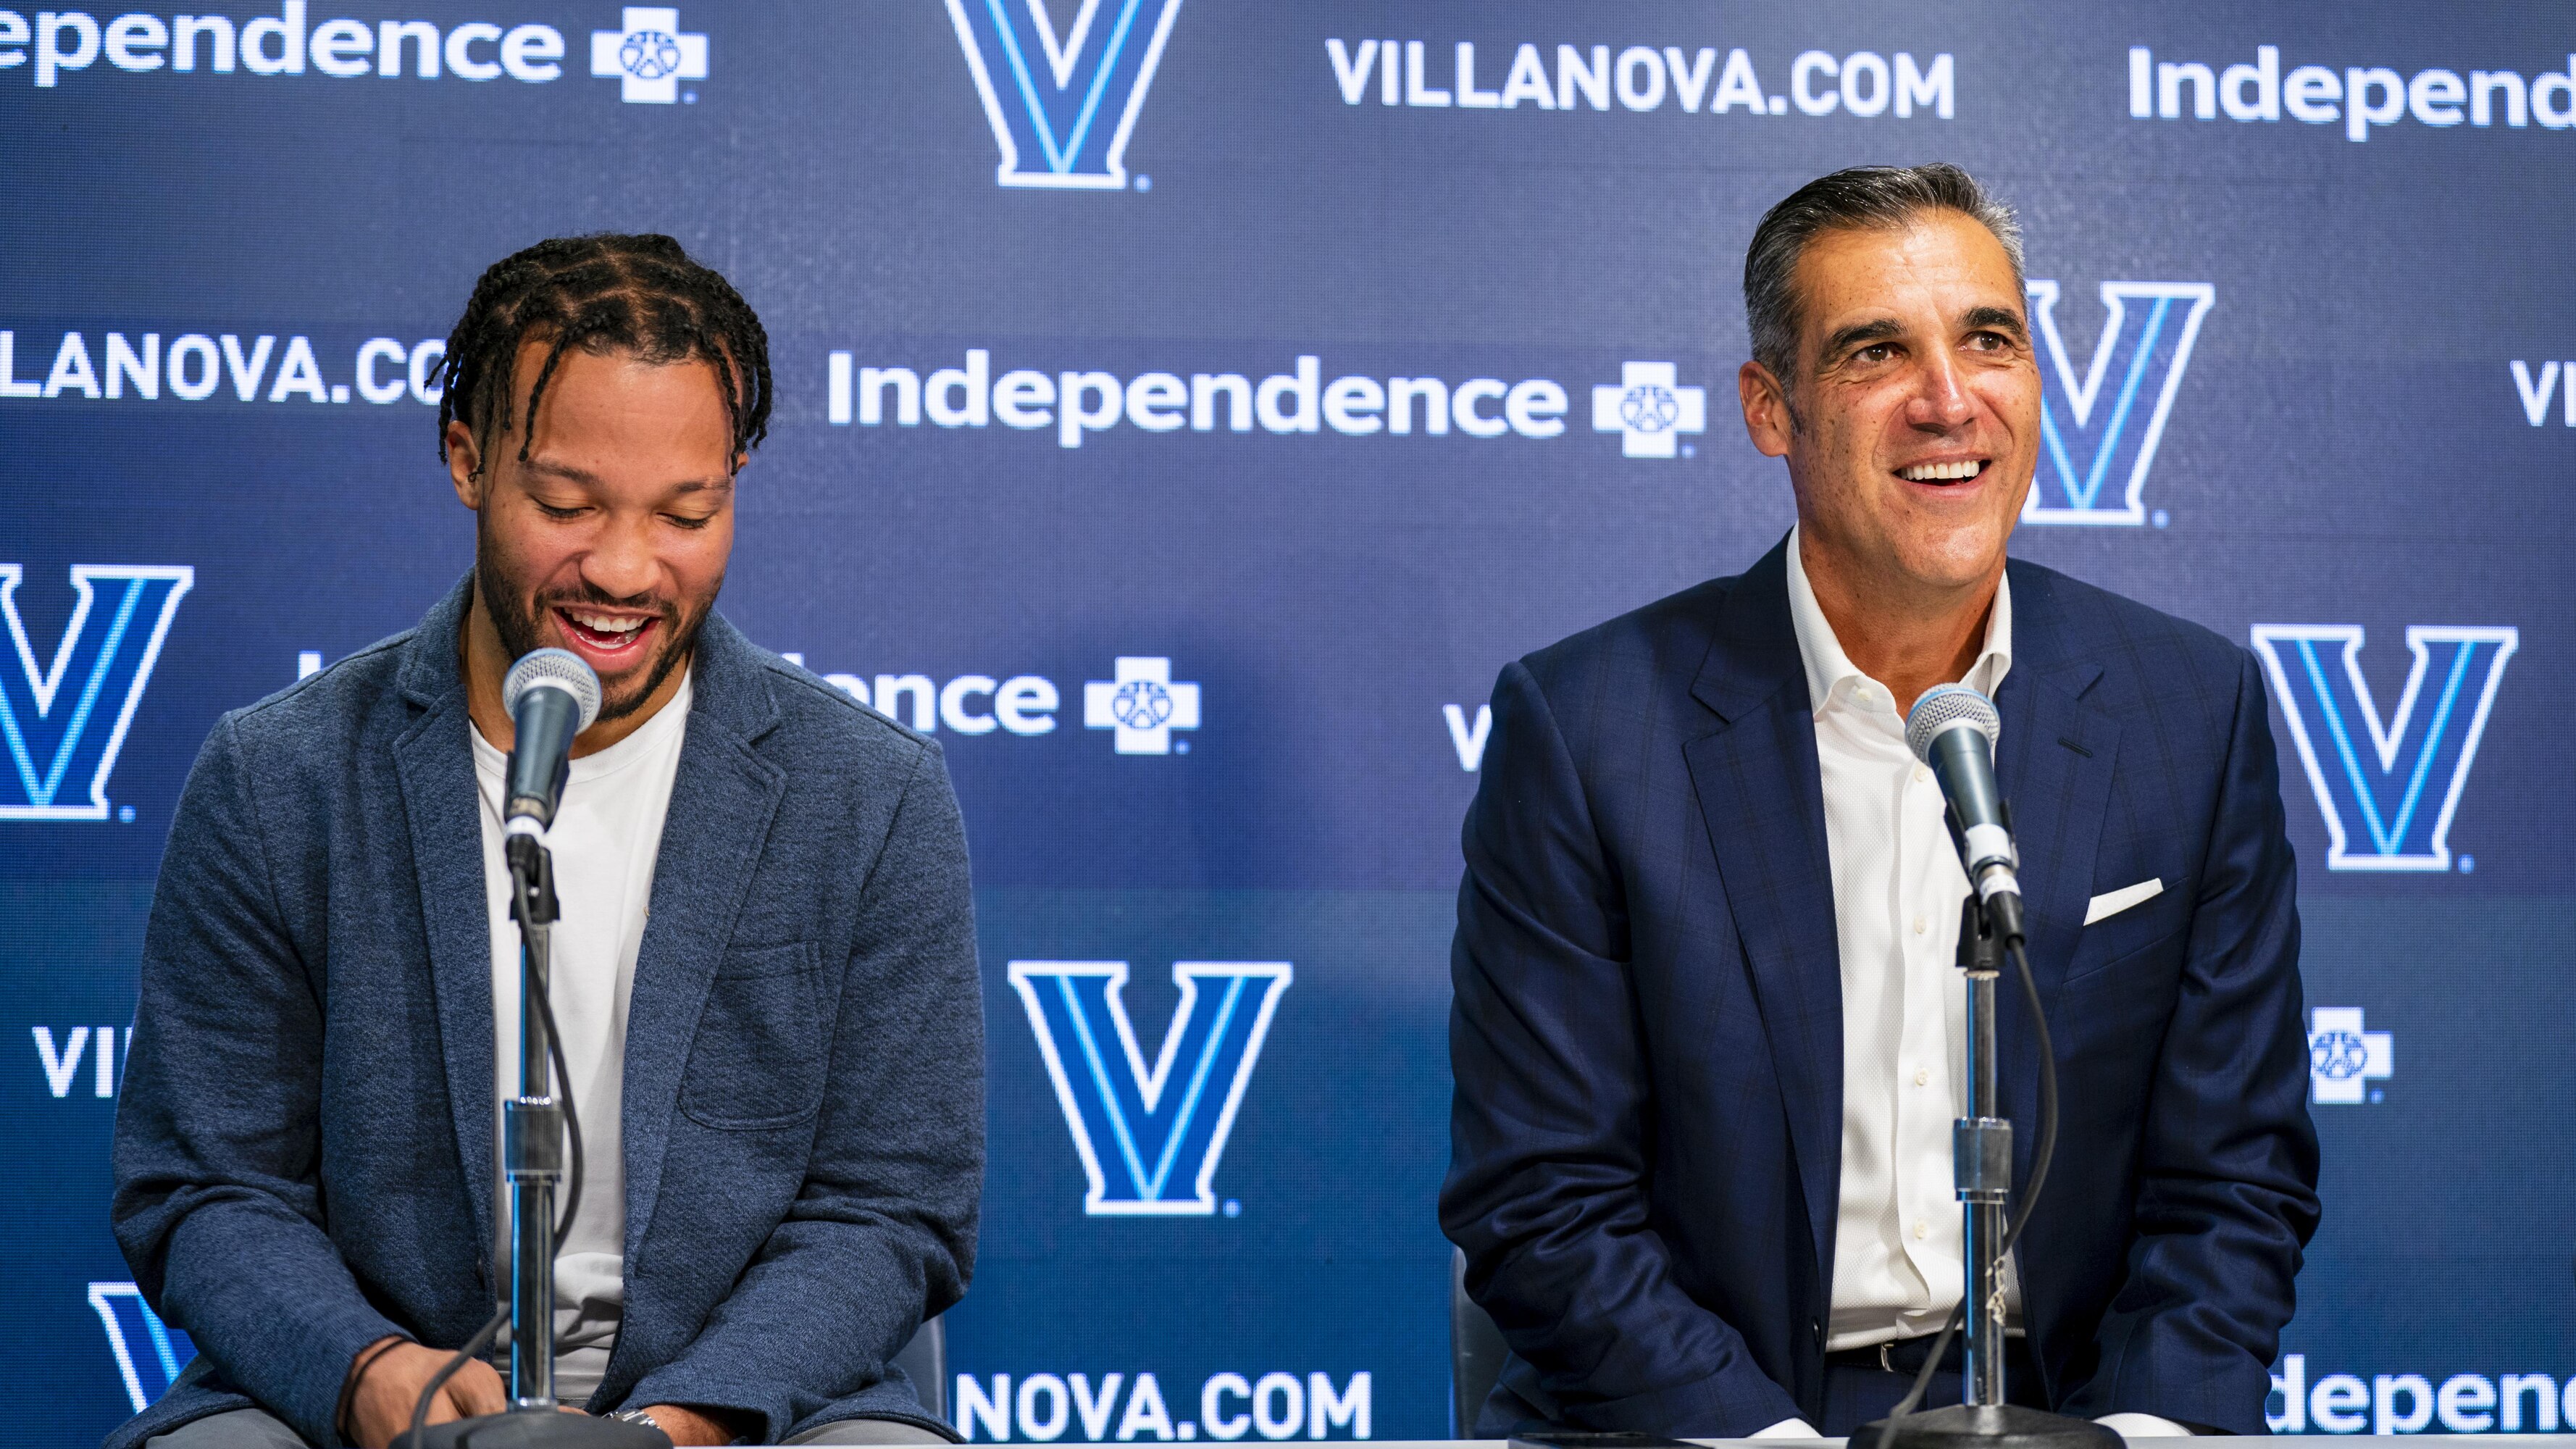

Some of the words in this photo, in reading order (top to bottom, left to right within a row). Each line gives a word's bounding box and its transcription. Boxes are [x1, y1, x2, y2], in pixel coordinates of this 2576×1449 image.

[943, 0, 1184, 189] V
[1326, 38, 1956, 120] VILLANOVA.COM
[2128, 45, 2576, 143] Independ
[828, 347, 1569, 448] Independence
[2020, 278, 2216, 527] V
[2250, 622, 2519, 871] V
[33, 1026, 133, 1098] VI
[1007, 960, 1293, 1216] V
[955, 1371, 1372, 1441] NOVA.COM
[2265, 1353, 2576, 1435] depen
